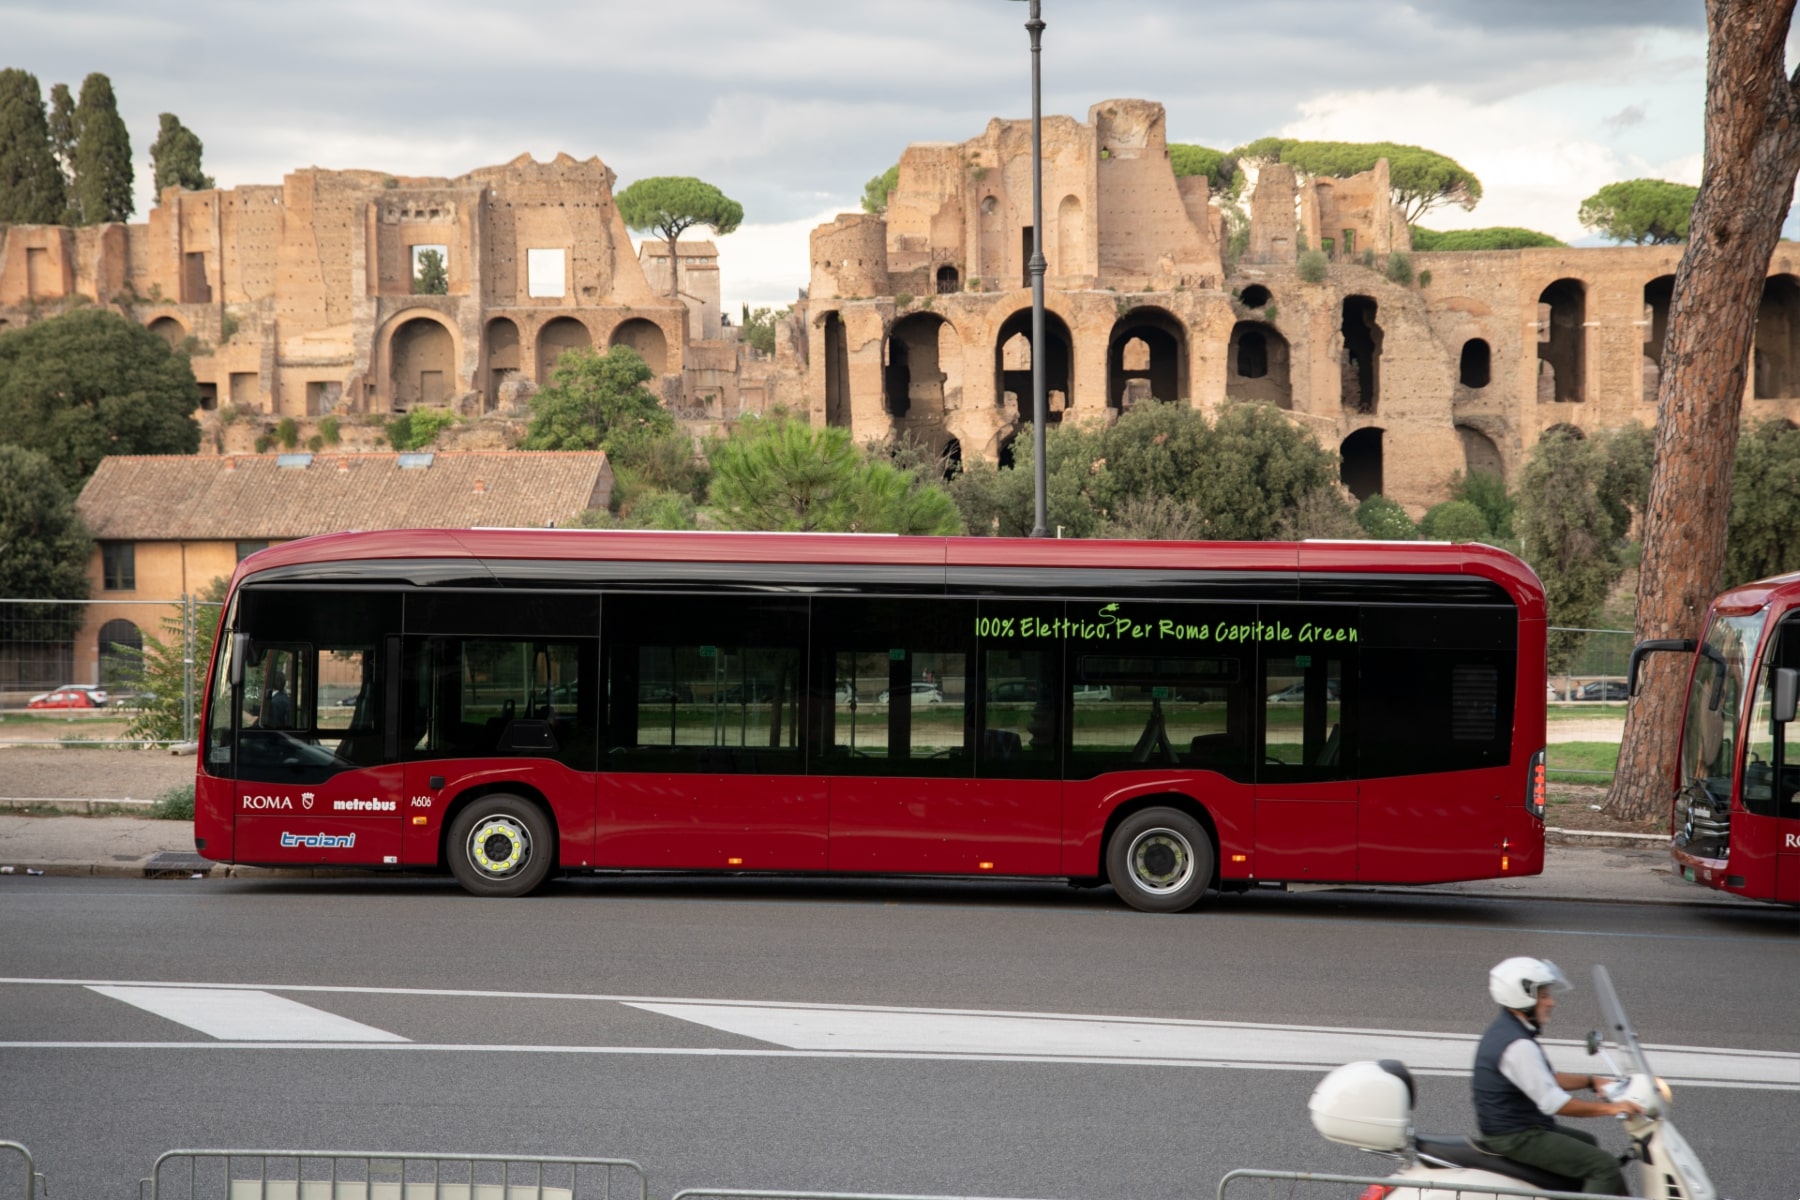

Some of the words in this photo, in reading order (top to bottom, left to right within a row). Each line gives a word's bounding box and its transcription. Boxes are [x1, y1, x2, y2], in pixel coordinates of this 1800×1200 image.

[976, 617, 1015, 638] 100%
[1116, 618, 1152, 639] Per
[1159, 620, 1209, 639] Roma
[1215, 621, 1292, 643] Capitale
[1299, 623, 1358, 642] Green
[243, 796, 293, 809] ROMA
[333, 798, 396, 811] metrebus
[411, 796, 432, 807] A606
[281, 832, 356, 848] troiani
